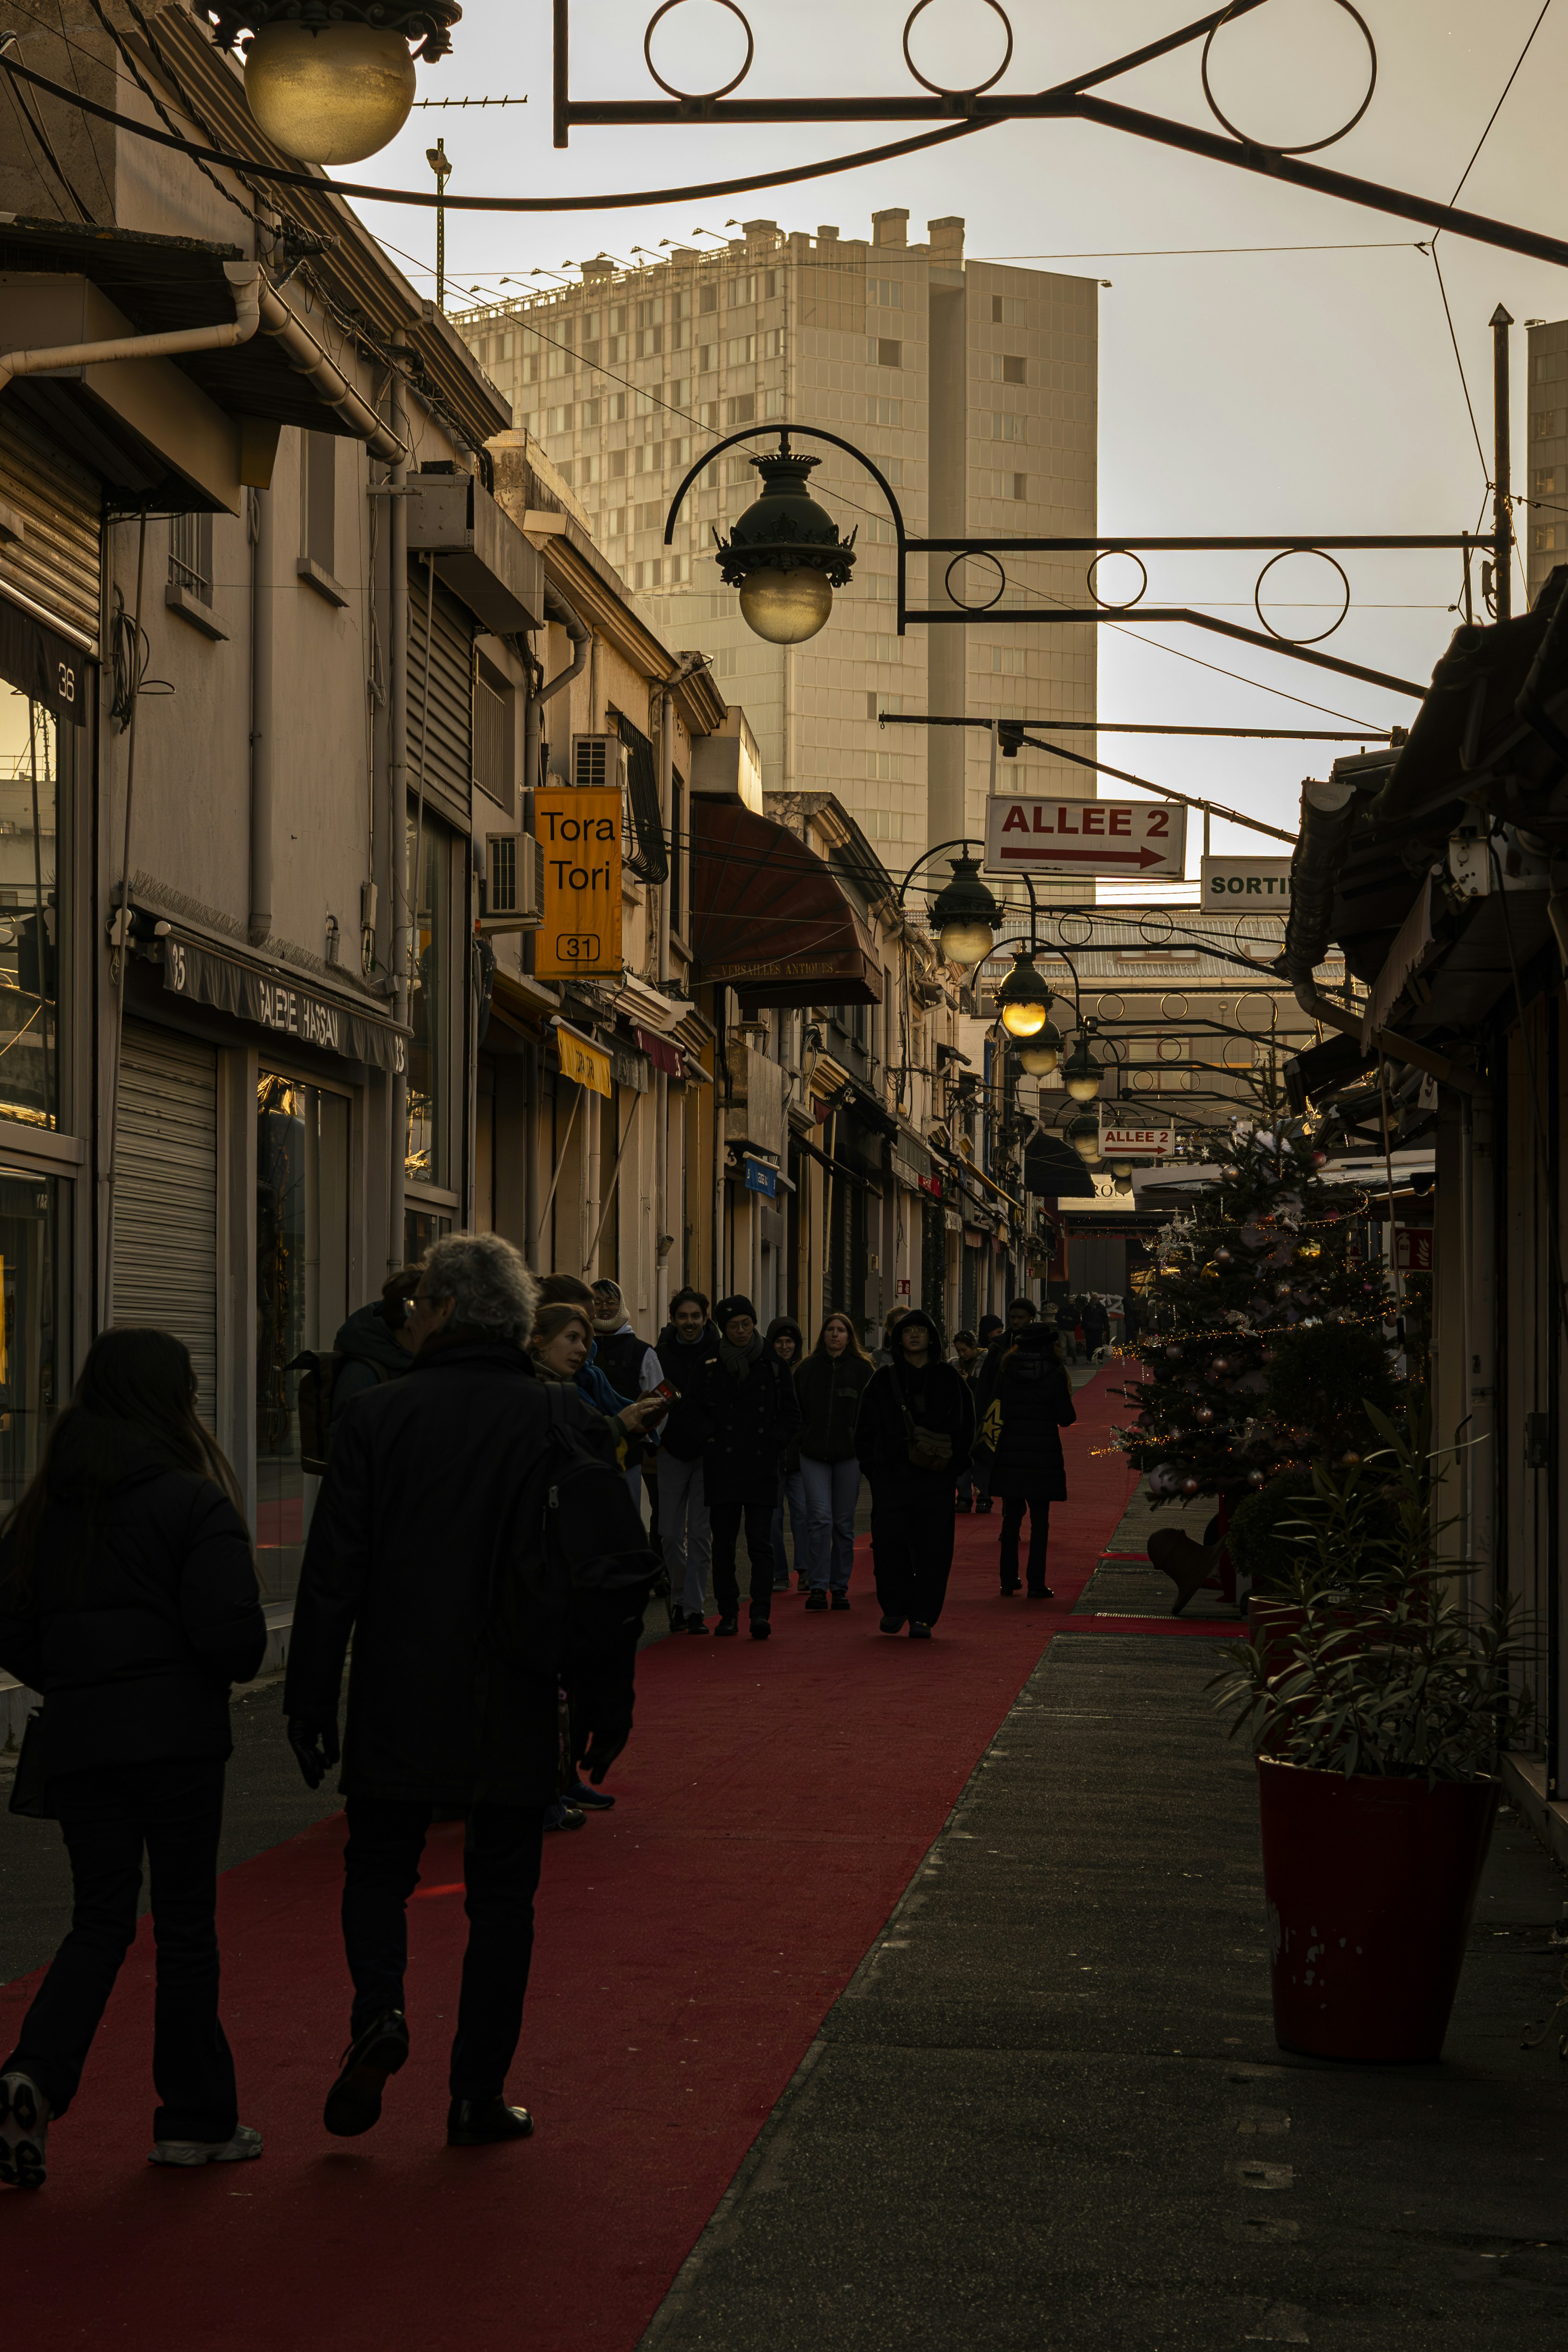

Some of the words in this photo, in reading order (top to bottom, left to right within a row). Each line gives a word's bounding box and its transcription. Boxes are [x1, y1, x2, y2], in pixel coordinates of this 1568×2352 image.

[59, 662, 74, 702] 36
[540, 811, 615, 841] Tora
[1001, 805, 1132, 836] ALLEE
[1146, 810, 1169, 837] 2
[549, 860, 610, 890] Tori
[1211, 876, 1291, 895] SORTI
[567, 938, 590, 958] 31
[172, 943, 185, 990] 35
[721, 963, 781, 977] VERSAILLES
[785, 962, 833, 975] ANTIQUES
[260, 980, 298, 1032] GALERIE
[303, 999, 338, 1047] HASSAN
[1105, 1131, 1155, 1143] ALLEE
[1159, 1131, 1169, 1143] 2
